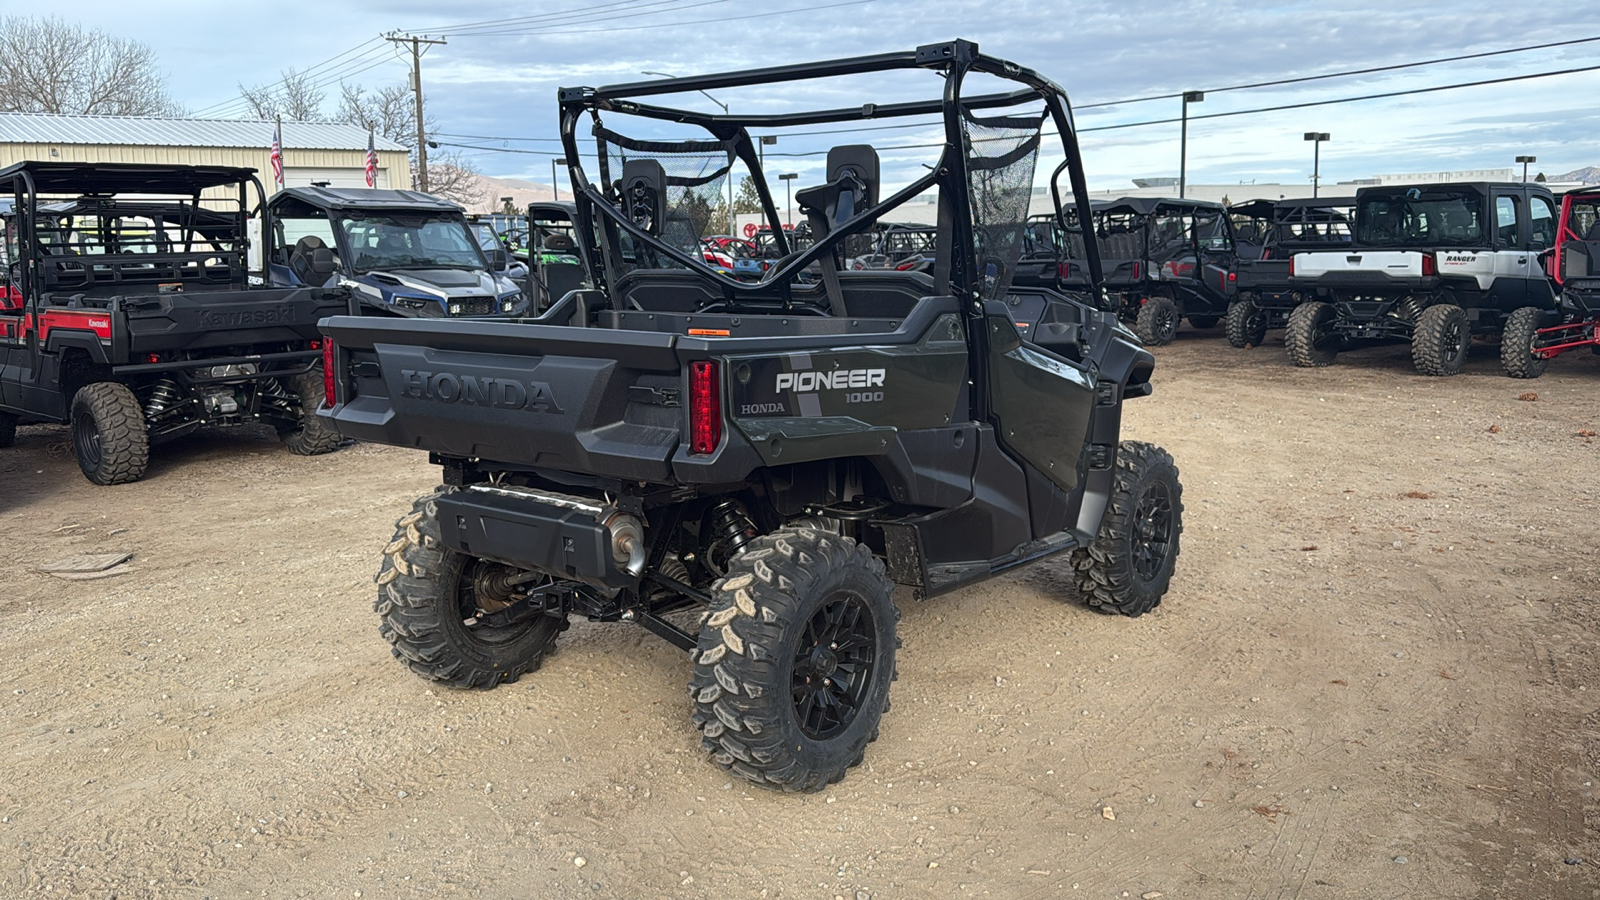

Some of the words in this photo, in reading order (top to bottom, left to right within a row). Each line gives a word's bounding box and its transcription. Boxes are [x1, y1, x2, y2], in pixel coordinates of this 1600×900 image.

[194, 304, 296, 328] Kawasaki
[400, 369, 565, 415] HONDA
[775, 368, 887, 394] PIONEER
[741, 402, 785, 415] HONDA
[845, 391, 885, 404] 1000
